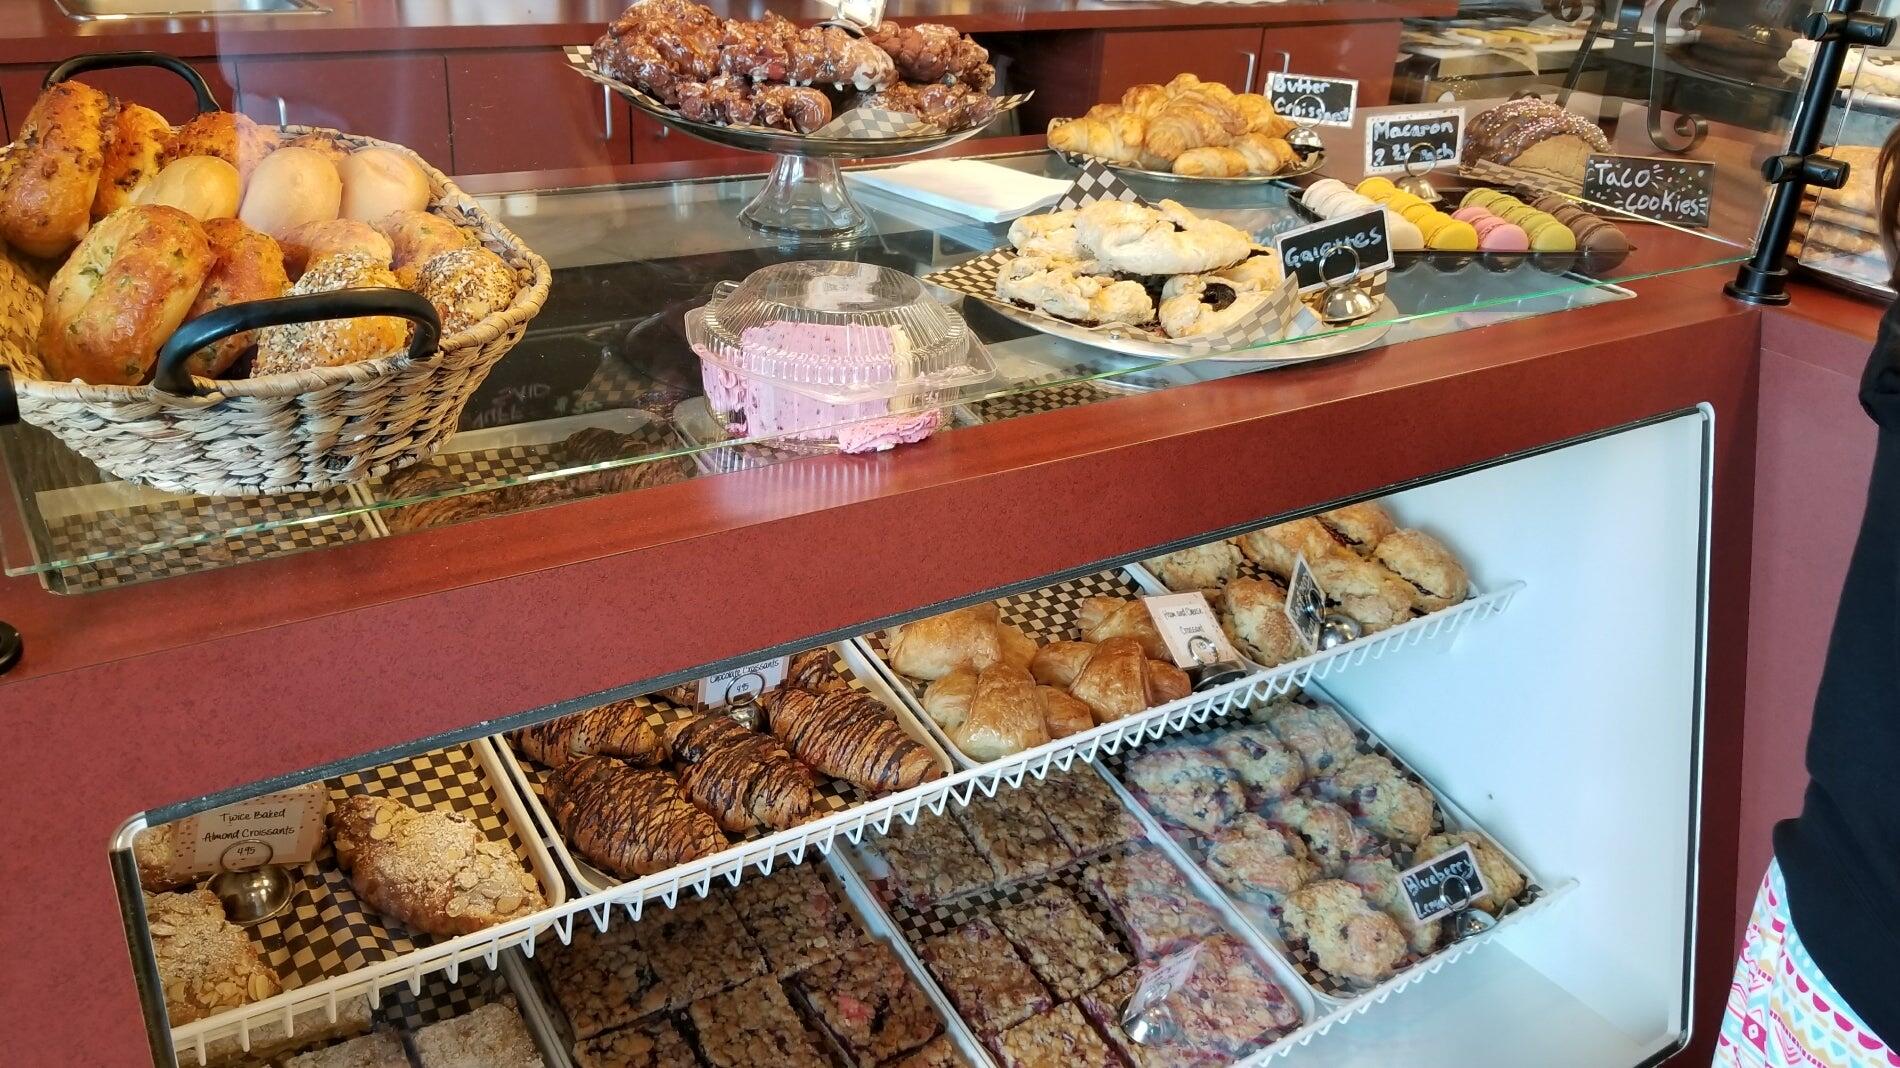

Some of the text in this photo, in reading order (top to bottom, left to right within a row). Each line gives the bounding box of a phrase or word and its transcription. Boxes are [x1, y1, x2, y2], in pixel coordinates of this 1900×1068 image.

[1273, 76, 1330, 94] Butter
[1373, 120, 1454, 141] Macaron
[220, 808, 286, 823] Twice Baked
[202, 825, 296, 842] Almond Croissants
[1402, 859, 1474, 896] Blueberry
